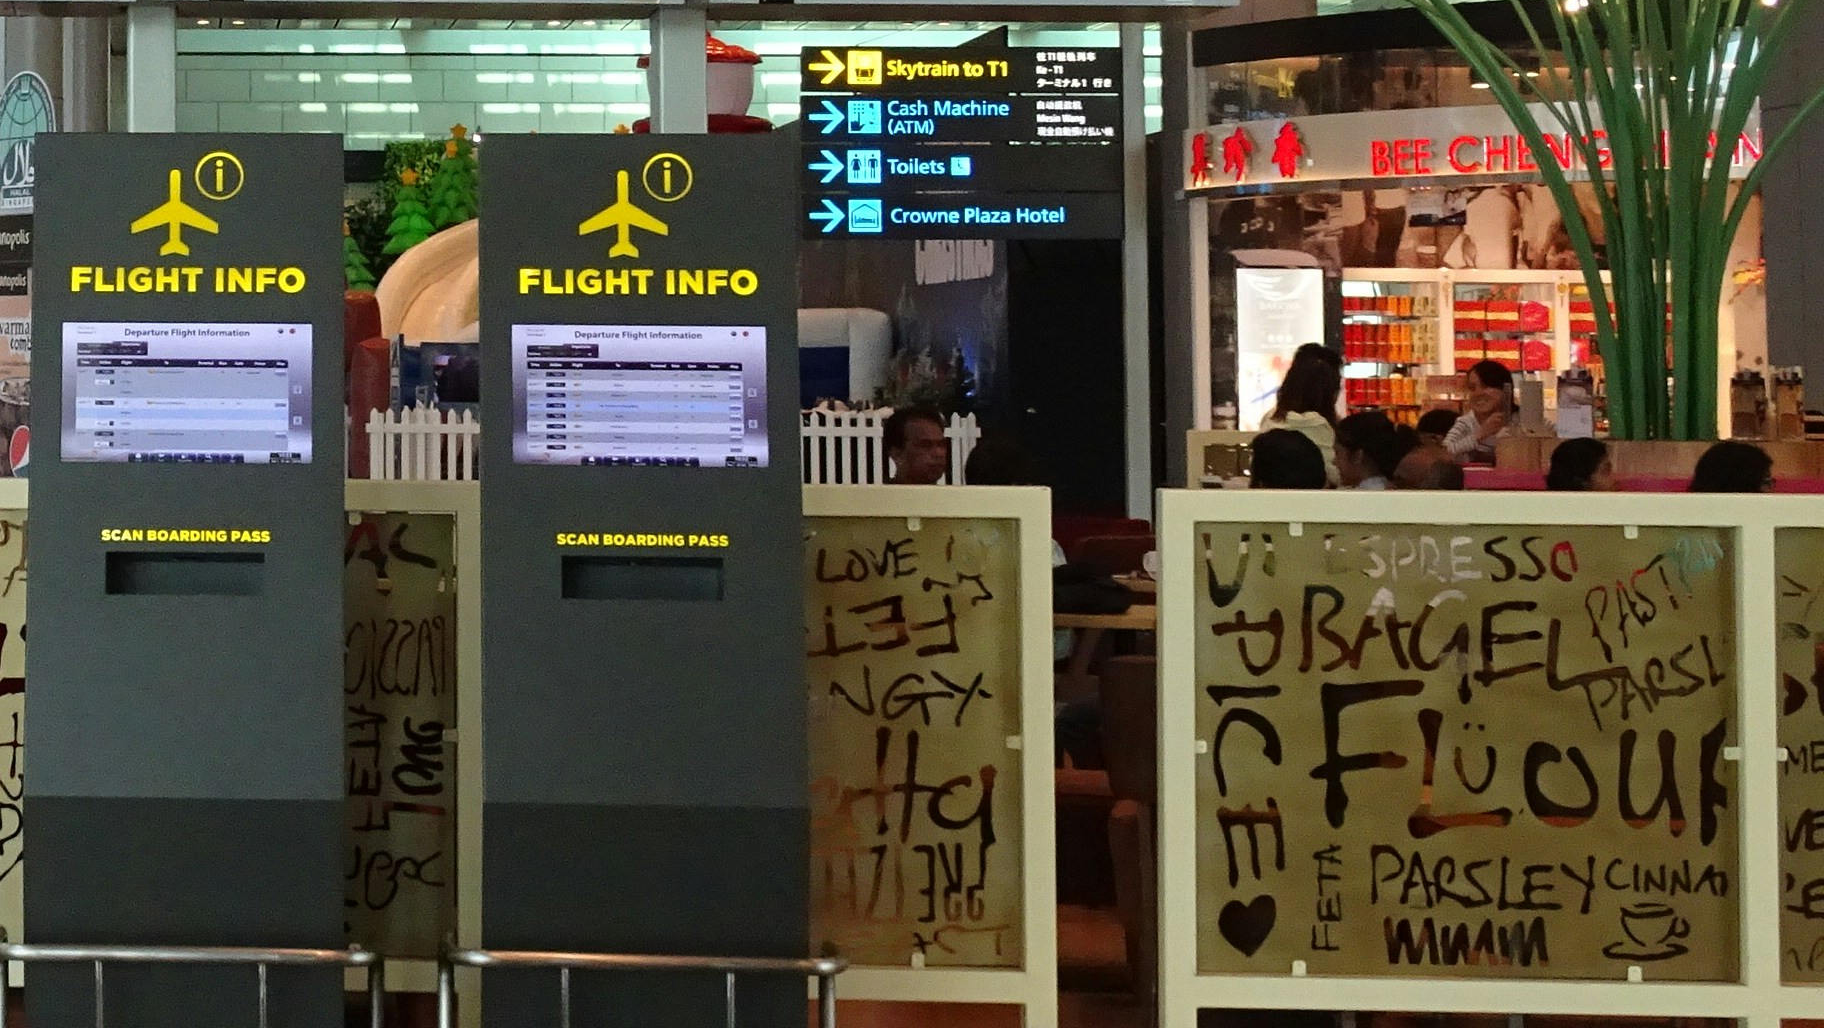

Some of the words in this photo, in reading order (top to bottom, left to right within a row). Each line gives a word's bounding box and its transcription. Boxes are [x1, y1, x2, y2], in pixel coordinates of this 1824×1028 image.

[887, 60, 959, 80] Skytrain
[963, 62, 983, 77] to
[987, 61, 1007, 76] T1
[888, 100, 928, 115] Cash
[934, 101, 1009, 115] Machine
[888, 119, 934, 135] (ATM)
[1371, 139, 1433, 176] BEE
[887, 158, 945, 174] Toilets
[891, 208, 960, 223] Crowne
[965, 208, 1011, 223] Plaza
[1017, 207, 1064, 223] Hotel
[72, 267, 203, 292] FLIGHT
[216, 268, 305, 293] INFO
[520, 269, 653, 294] FLIGHT
[667, 270, 757, 295] INFO
[124, 328, 168, 339] Departure
[171, 329, 195, 338] Flight
[575, 331, 619, 339] Departure
[622, 332, 647, 340] Flight
[102, 530, 143, 541] SCAN
[147, 530, 227, 541] BOARDING
[231, 531, 270, 542] PASS
[557, 534, 599, 545] SCAN
[603, 534, 684, 546] BOARDING
[689, 535, 728, 546] PASS
[1298, 585, 1628, 704] BAGEL
[1370, 844, 1596, 914] PARSLEY
[1312, 844, 1342, 950] FETA
